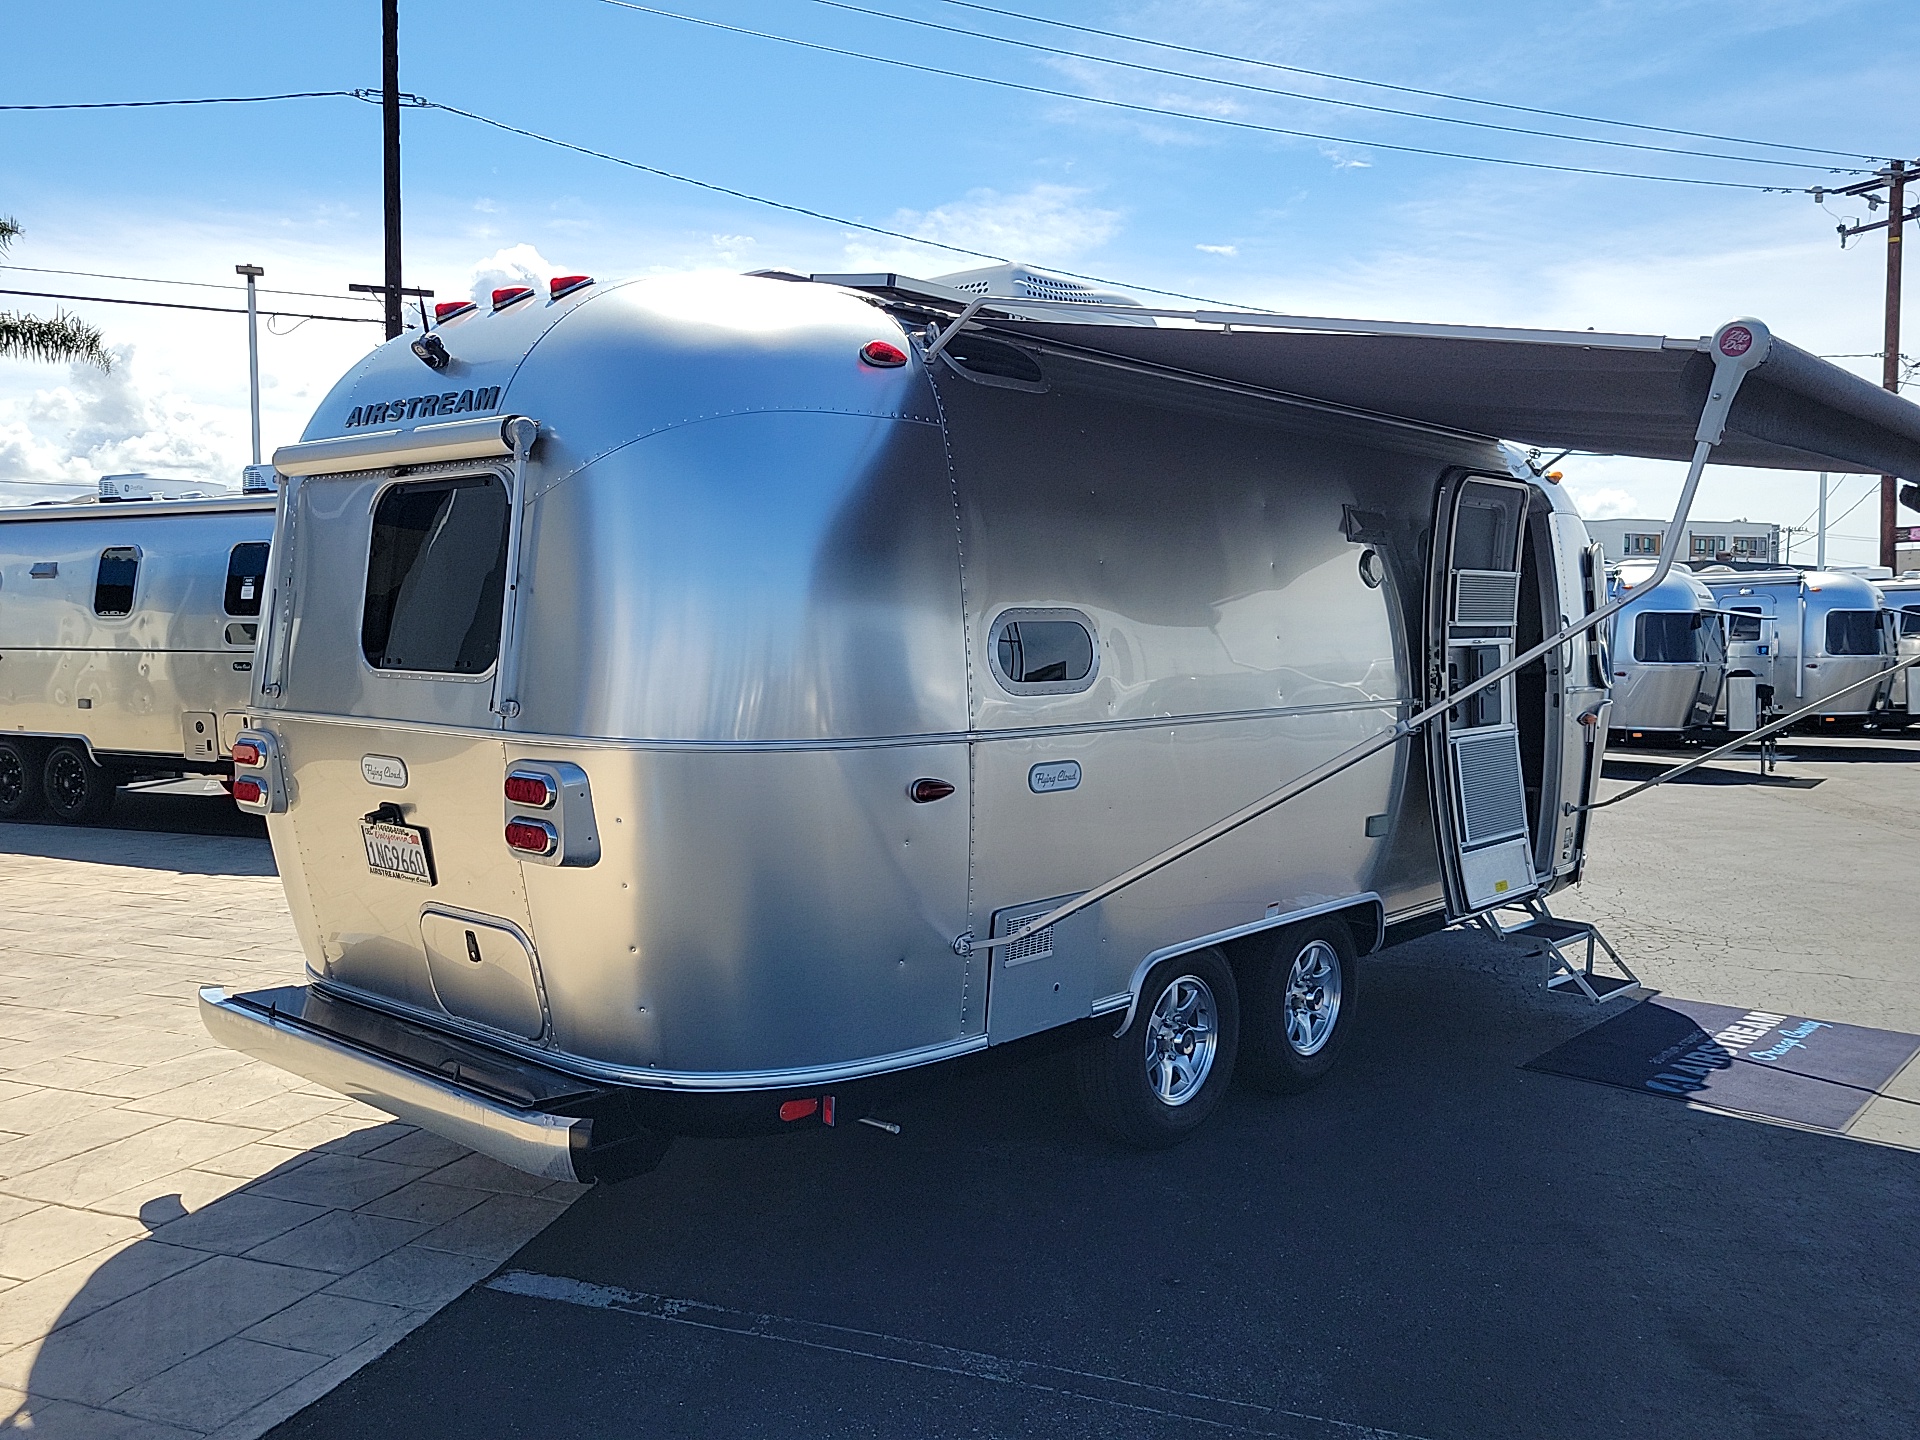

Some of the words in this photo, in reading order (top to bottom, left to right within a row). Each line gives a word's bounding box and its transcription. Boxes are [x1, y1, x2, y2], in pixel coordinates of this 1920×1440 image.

[1722, 340, 1747, 351] Dee
[1728, 330, 1750, 343] Zip
[345, 385, 501, 428] AIRSTREAM
[365, 764, 383, 780] Flying
[384, 766, 402, 780] Cloud
[1035, 772, 1056, 787] Flying
[1057, 769, 1077, 782] Cloud
[369, 841, 426, 875] 1NG9660
[369, 867, 402, 880] AIRSTREAM
[1777, 1020, 1834, 1039] County
[1669, 1011, 1788, 1076] AIRSTREAM
[1748, 1037, 1807, 1060] Orange
